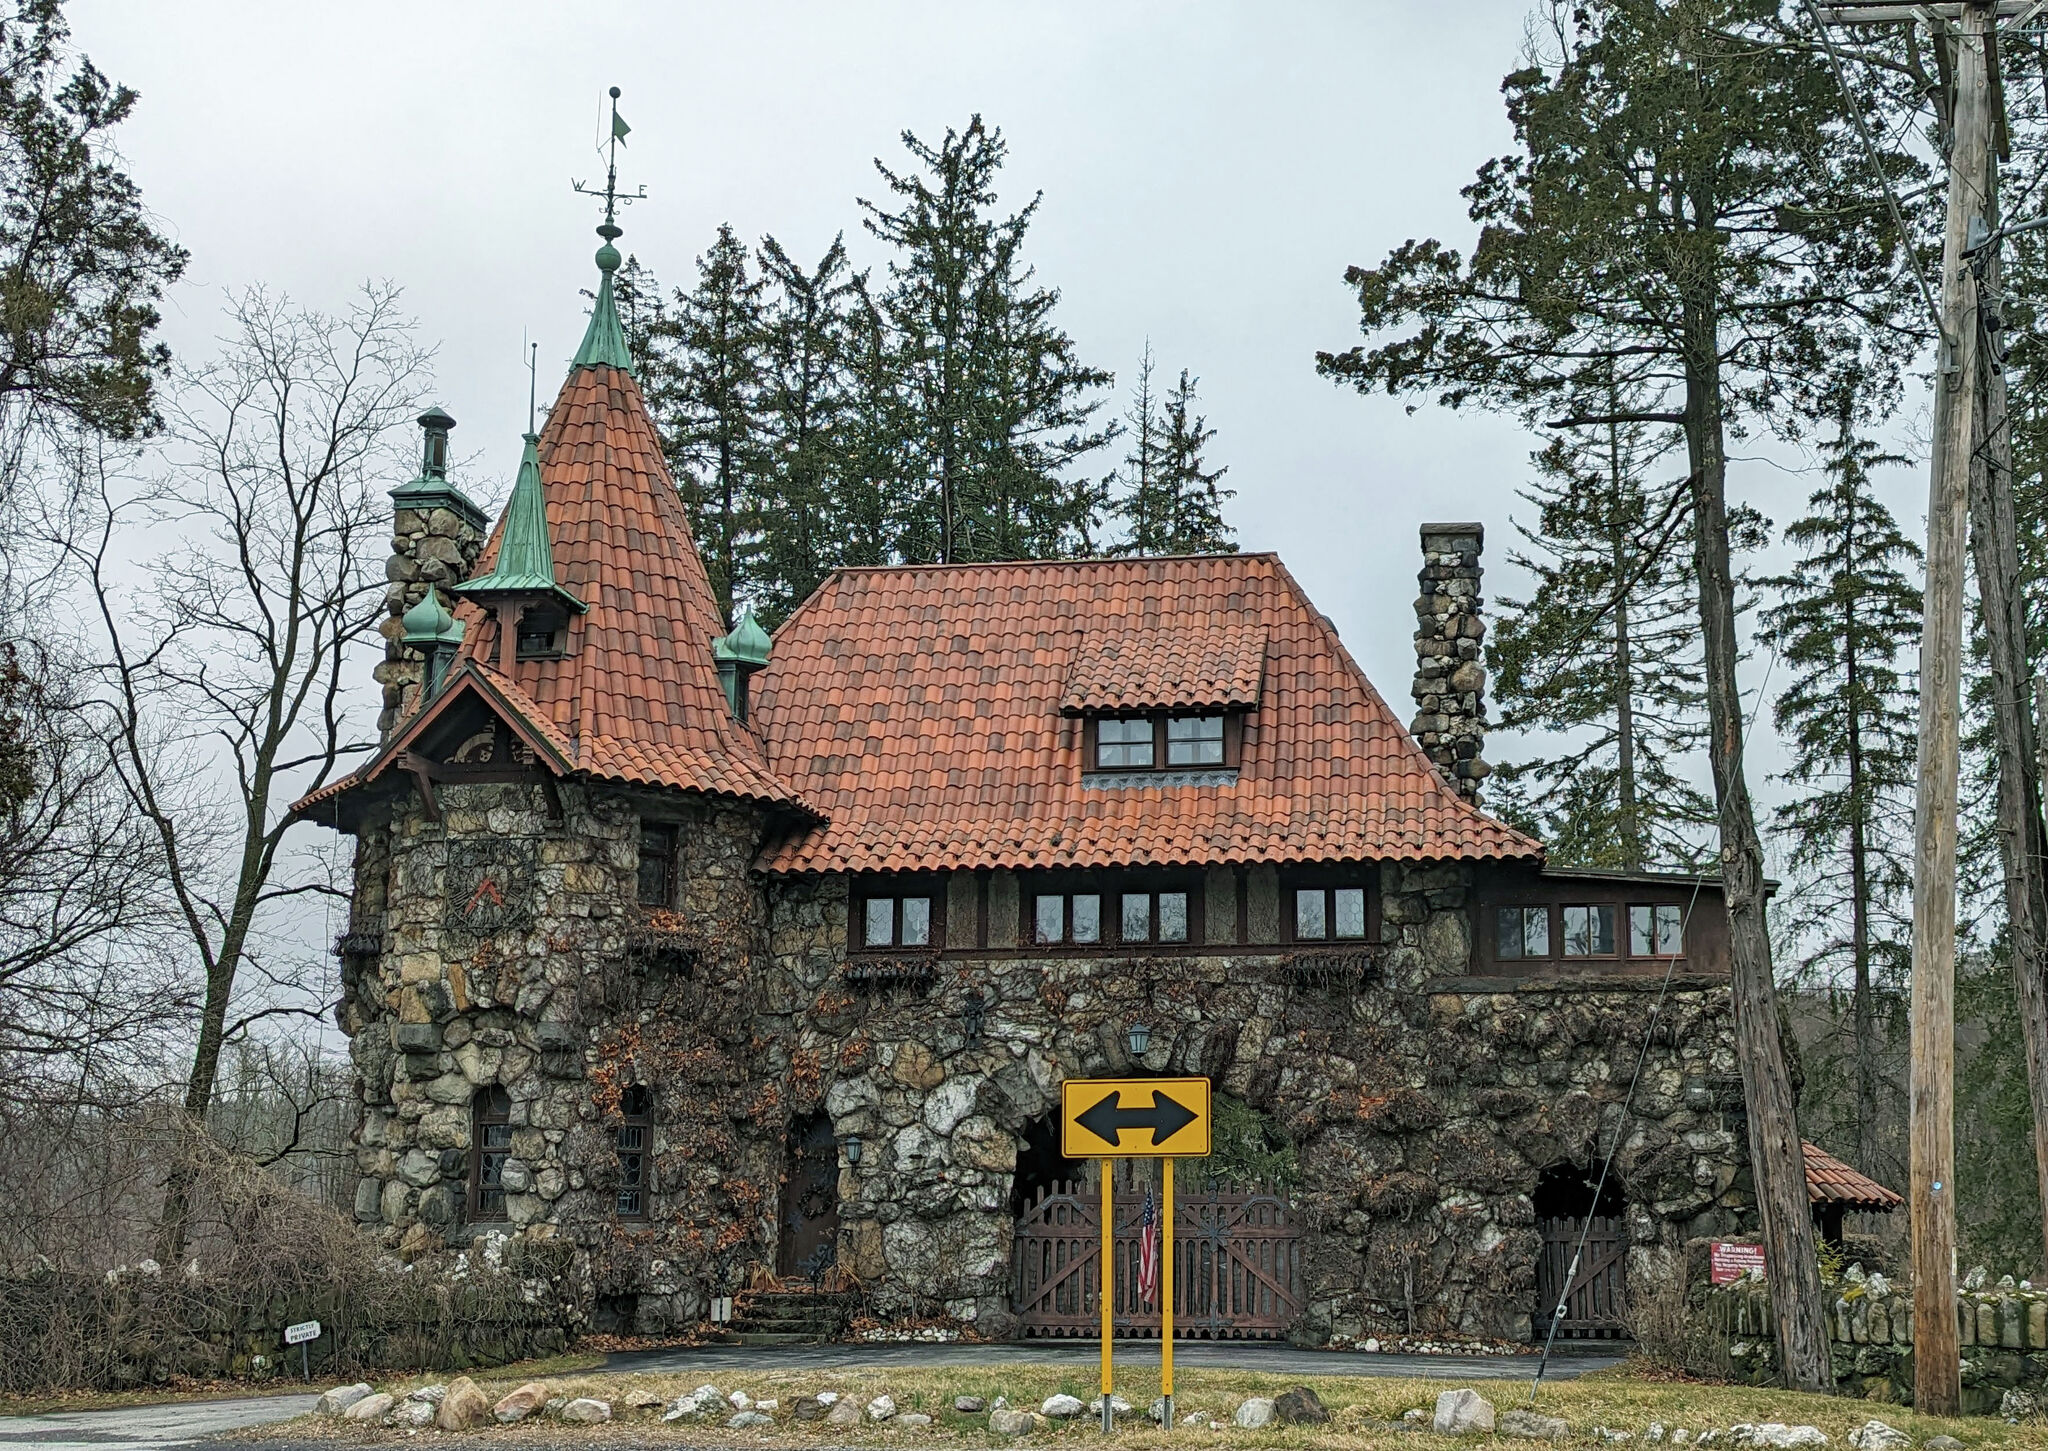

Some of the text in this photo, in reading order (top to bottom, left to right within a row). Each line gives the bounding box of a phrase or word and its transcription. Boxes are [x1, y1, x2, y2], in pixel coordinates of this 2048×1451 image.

[571, 177, 586, 191] W
[639, 184, 647, 198] E
[1719, 1246, 1757, 1254] WARNING!
[290, 1324, 314, 1334] STRICTLY
[290, 1330, 317, 1341] PRIVATE
